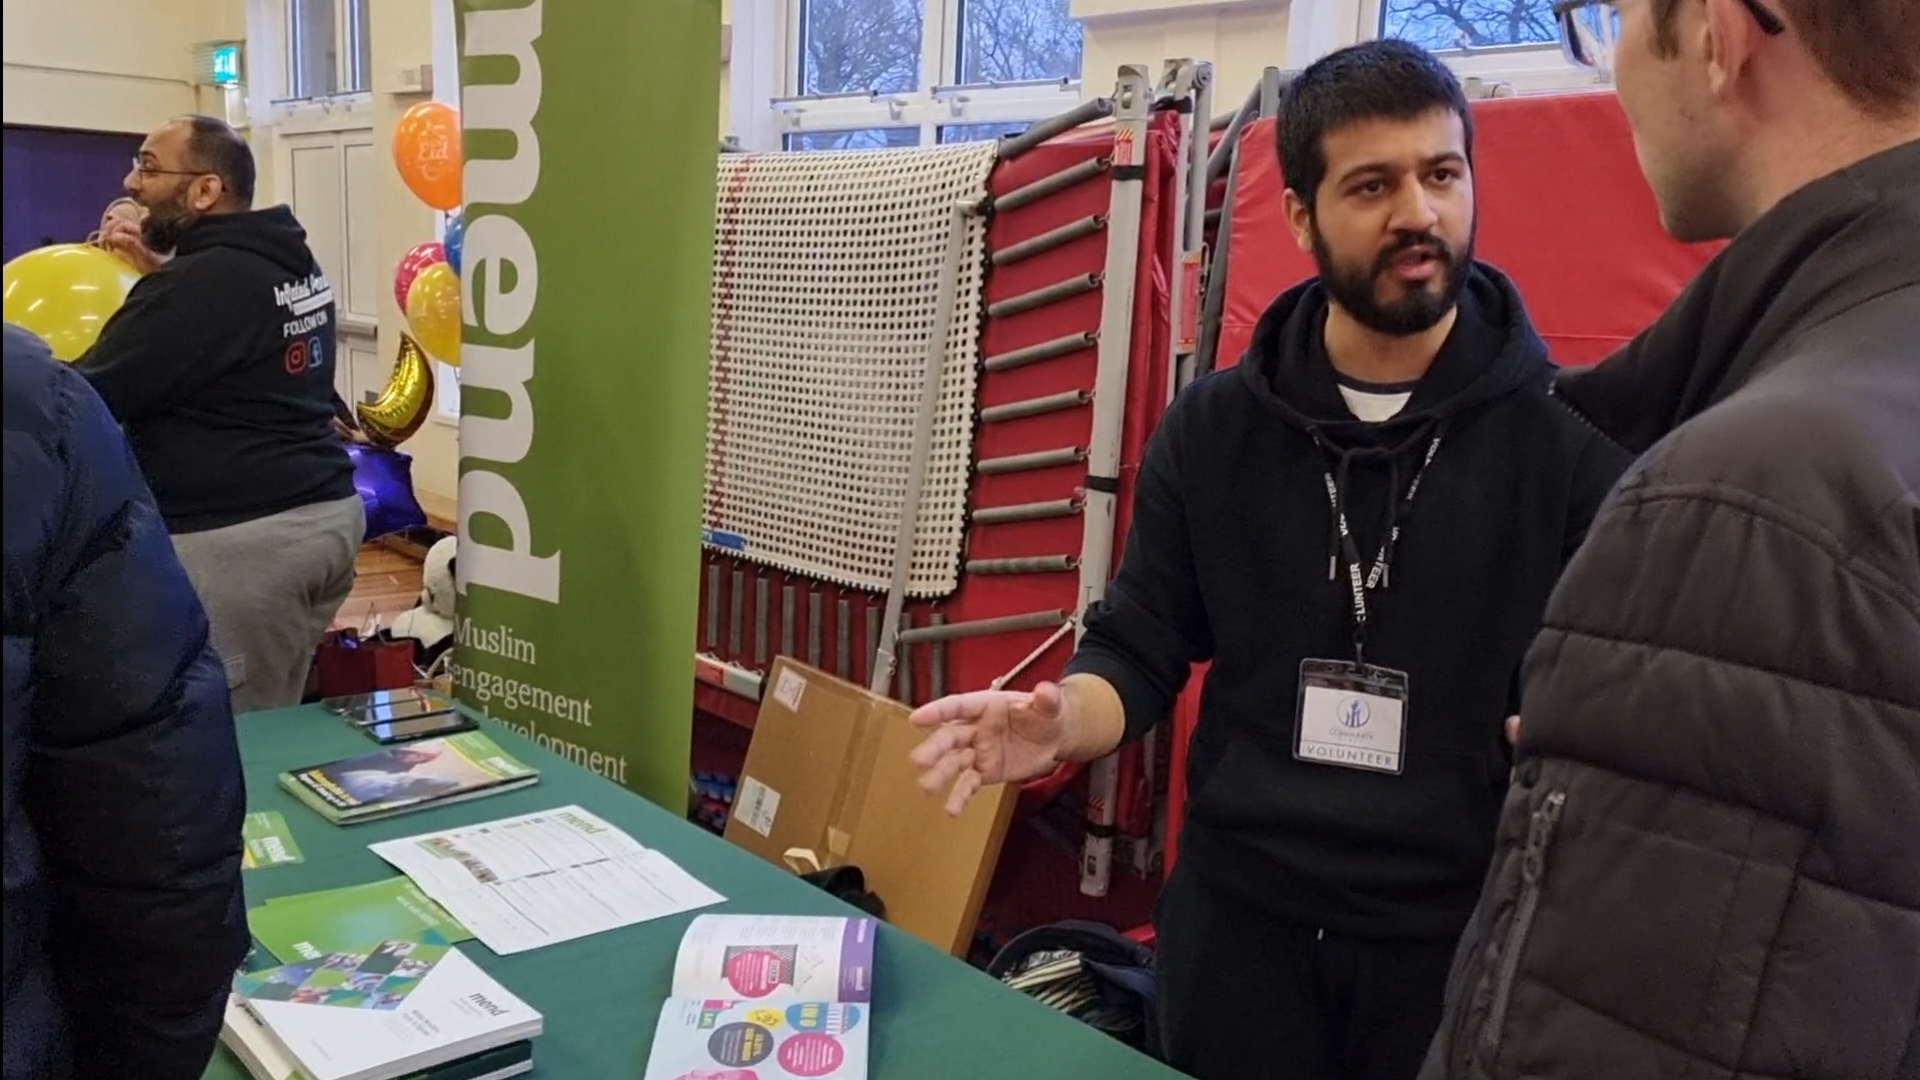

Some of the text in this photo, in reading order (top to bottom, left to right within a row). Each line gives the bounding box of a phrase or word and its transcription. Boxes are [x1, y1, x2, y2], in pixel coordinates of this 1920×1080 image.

[457, 0, 561, 604] mend
[283, 313, 317, 338] FOLLOW
[453, 613, 536, 665] Muslim
[452, 664, 592, 727] engagement
[1308, 745, 1392, 766] VOLUNTEER
[555, 811, 608, 835] mend
[468, 992, 510, 1017] mend
